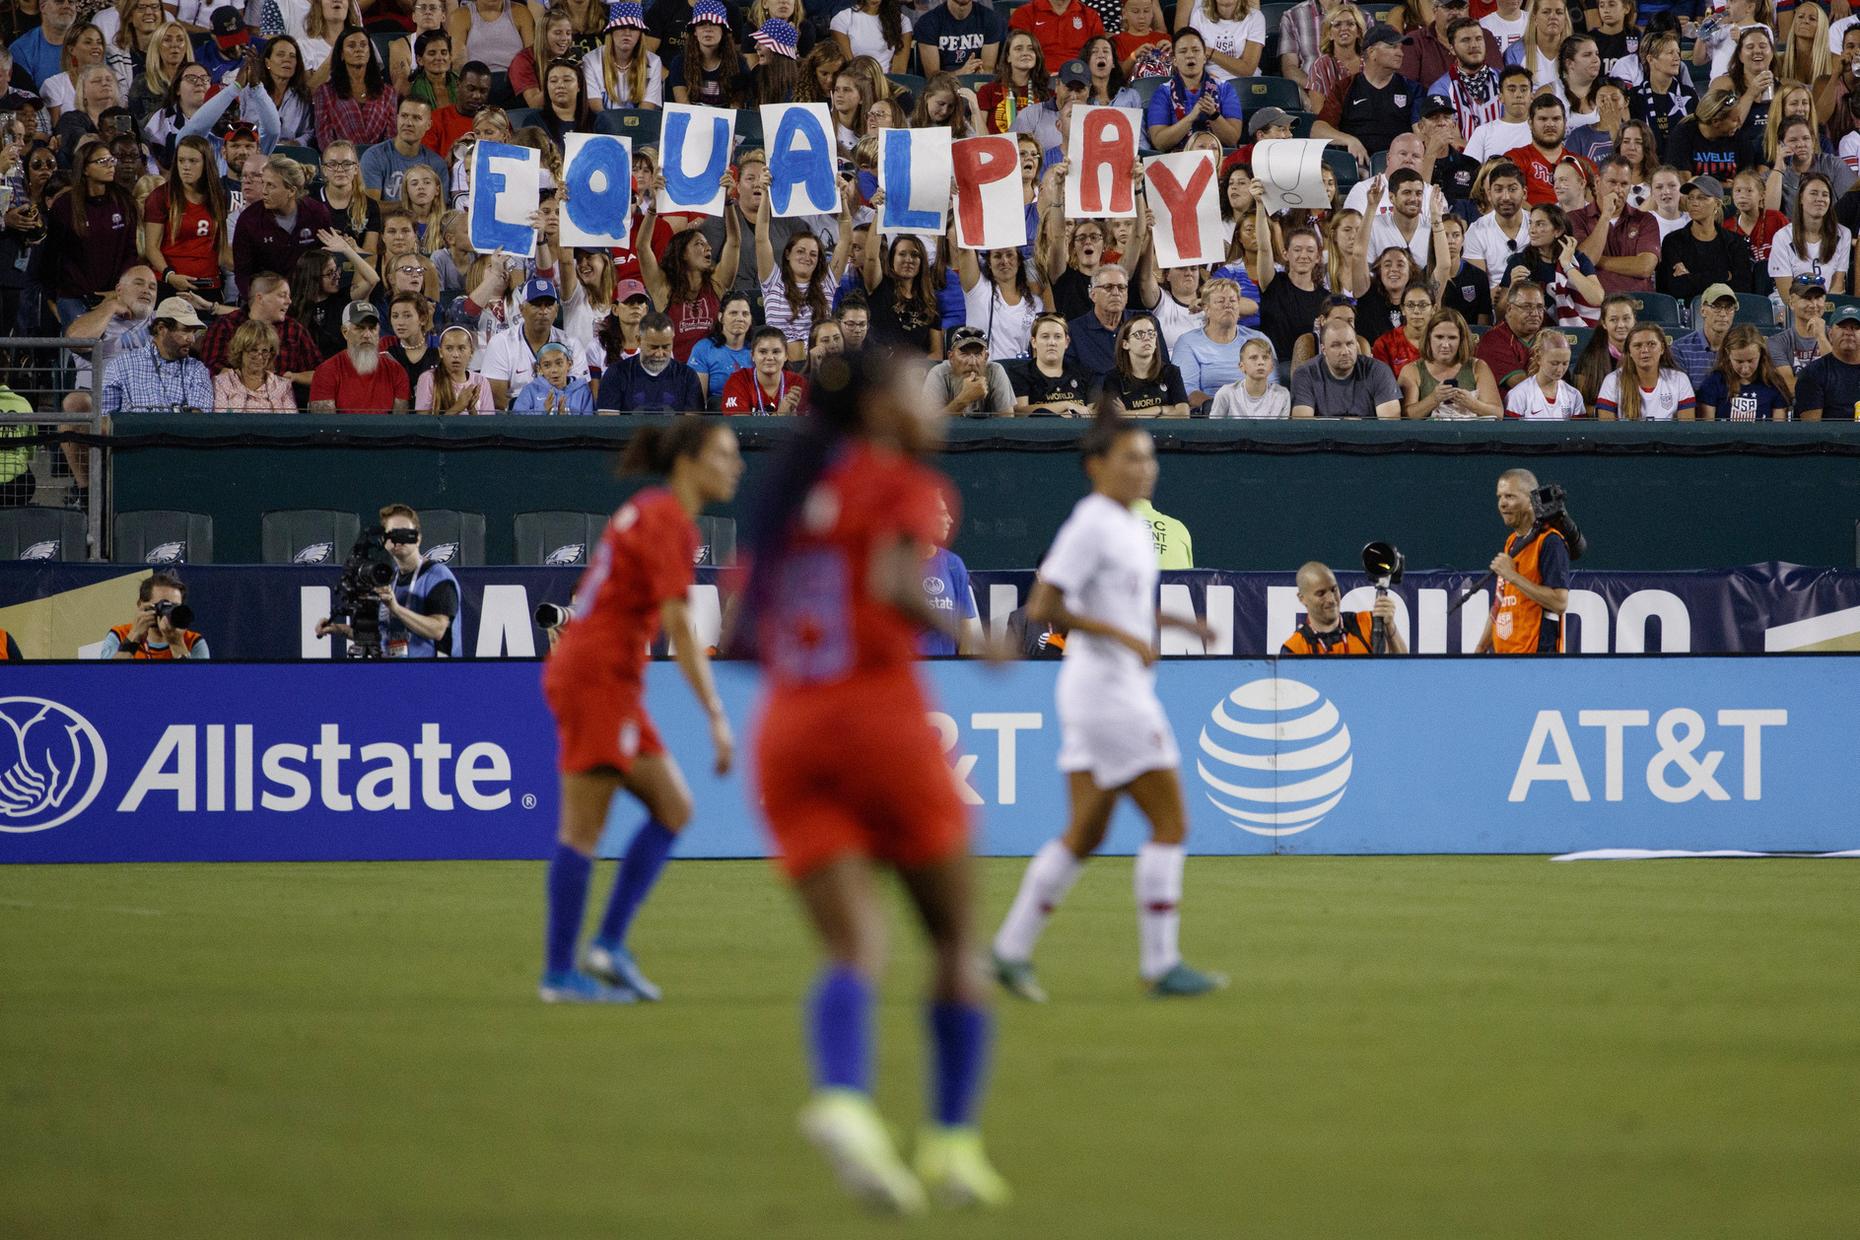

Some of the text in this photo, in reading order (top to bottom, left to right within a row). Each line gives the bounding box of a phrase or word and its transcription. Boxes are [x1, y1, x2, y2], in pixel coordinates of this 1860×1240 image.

[939, 34, 984, 50] PENN
[1216, 41, 1234, 52] USA
[471, 107, 941, 256] EQUAL
[951, 108, 1214, 260] PAY
[196, 219, 209, 237] 8
[614, 253, 637, 265] SA
[1046, 392, 1074, 401] WORLD
[1132, 397, 1162, 409] WORLD
[1733, 399, 1756, 413] USA
[1507, 707, 1788, 804] AT&T
[116, 723, 513, 812] Allstate
